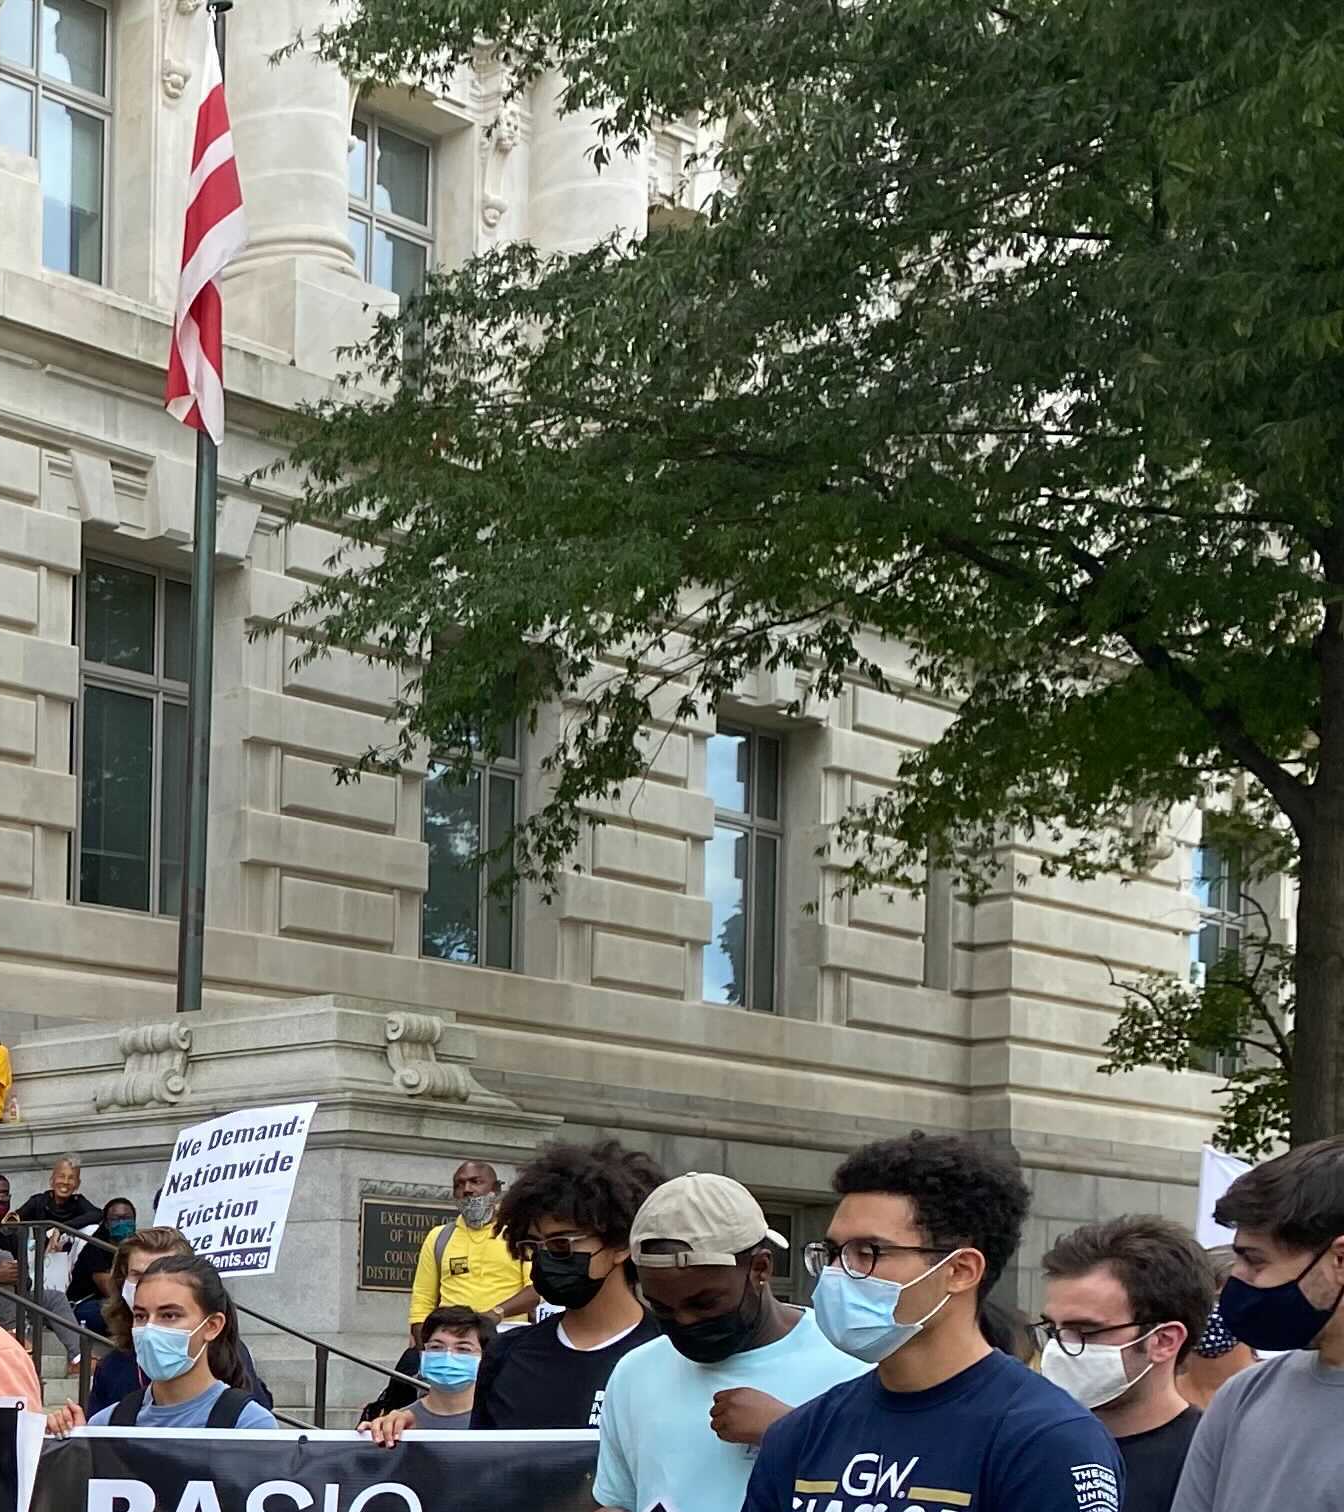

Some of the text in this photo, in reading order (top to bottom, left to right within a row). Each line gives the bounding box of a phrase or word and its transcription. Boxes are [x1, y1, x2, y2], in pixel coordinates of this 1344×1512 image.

[176, 1116, 305, 1161] We Demand:
[166, 1150, 294, 1197] Nationwide
[175, 1198, 259, 1231] Eviction
[220, 1221, 276, 1248] Now!
[390, 1229, 403, 1242] OF
